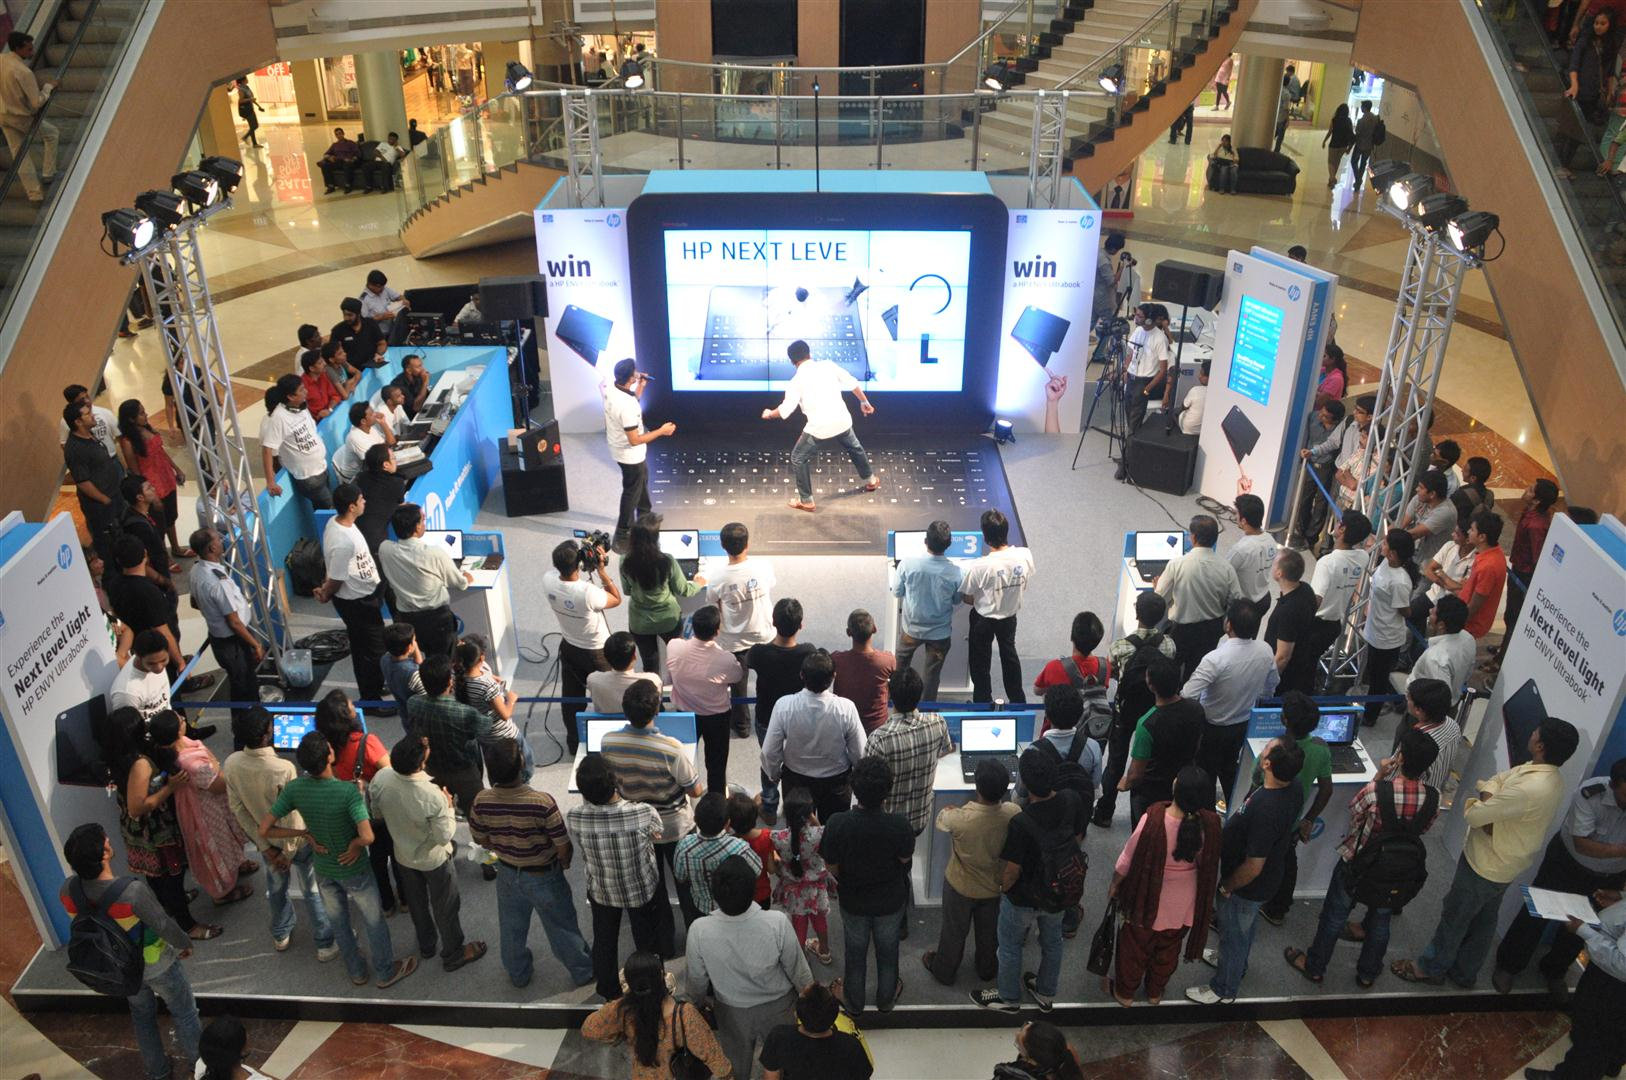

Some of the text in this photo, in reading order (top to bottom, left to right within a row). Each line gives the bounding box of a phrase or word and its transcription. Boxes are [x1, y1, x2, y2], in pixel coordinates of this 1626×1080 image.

[267, 65, 285, 76] OFF
[546, 254, 591, 277] win
[683, 241, 848, 261] HP NEXT LEVE
[1013, 254, 1057, 278] win
[963, 535, 978, 554] 3
[7, 611, 65, 678] Experience the
[1530, 604, 1605, 696] Next level light
[1536, 588, 1576, 637] Experience
[1576, 630, 1590, 651] the
[14, 605, 91, 698] Next level light
[21, 634, 89, 716] HP ENVY Ultrabook
[1523, 624, 1589, 703] HP ENVY Ultrabook
